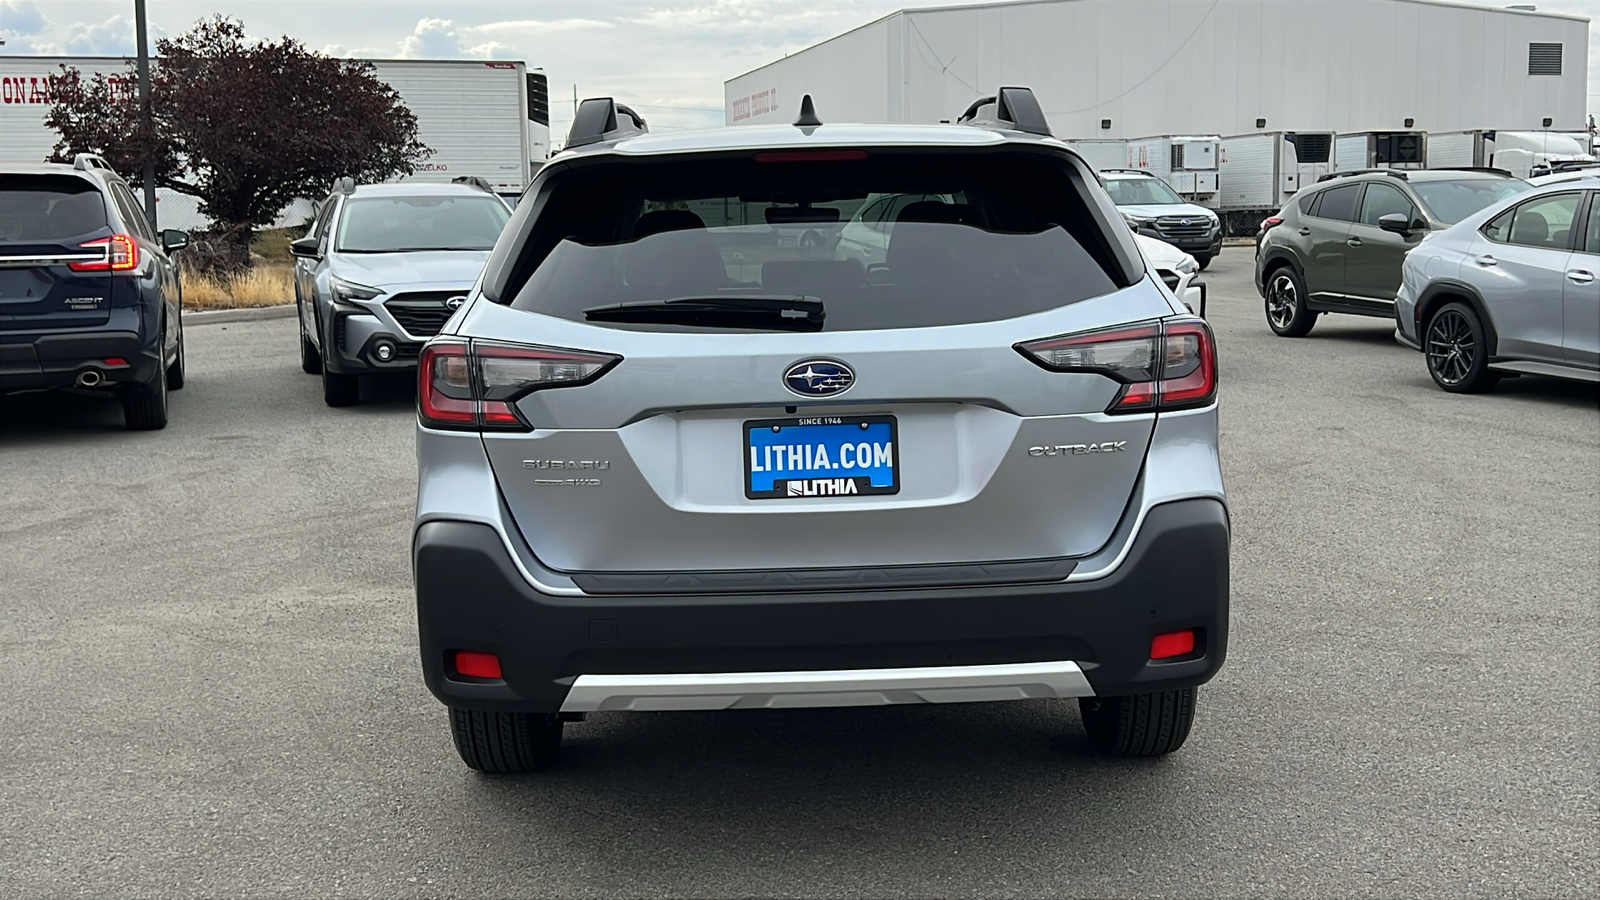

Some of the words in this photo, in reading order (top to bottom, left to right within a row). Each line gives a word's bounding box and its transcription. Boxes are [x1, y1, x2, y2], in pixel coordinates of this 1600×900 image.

[798, 417, 822, 426] SINCE
[824, 416, 842, 425] 1946
[750, 441, 893, 472] LITHIA.COM
[1027, 440, 1127, 457] OUTBACK
[522, 459, 610, 470] SUBARU
[803, 477, 858, 496] LITHIA
